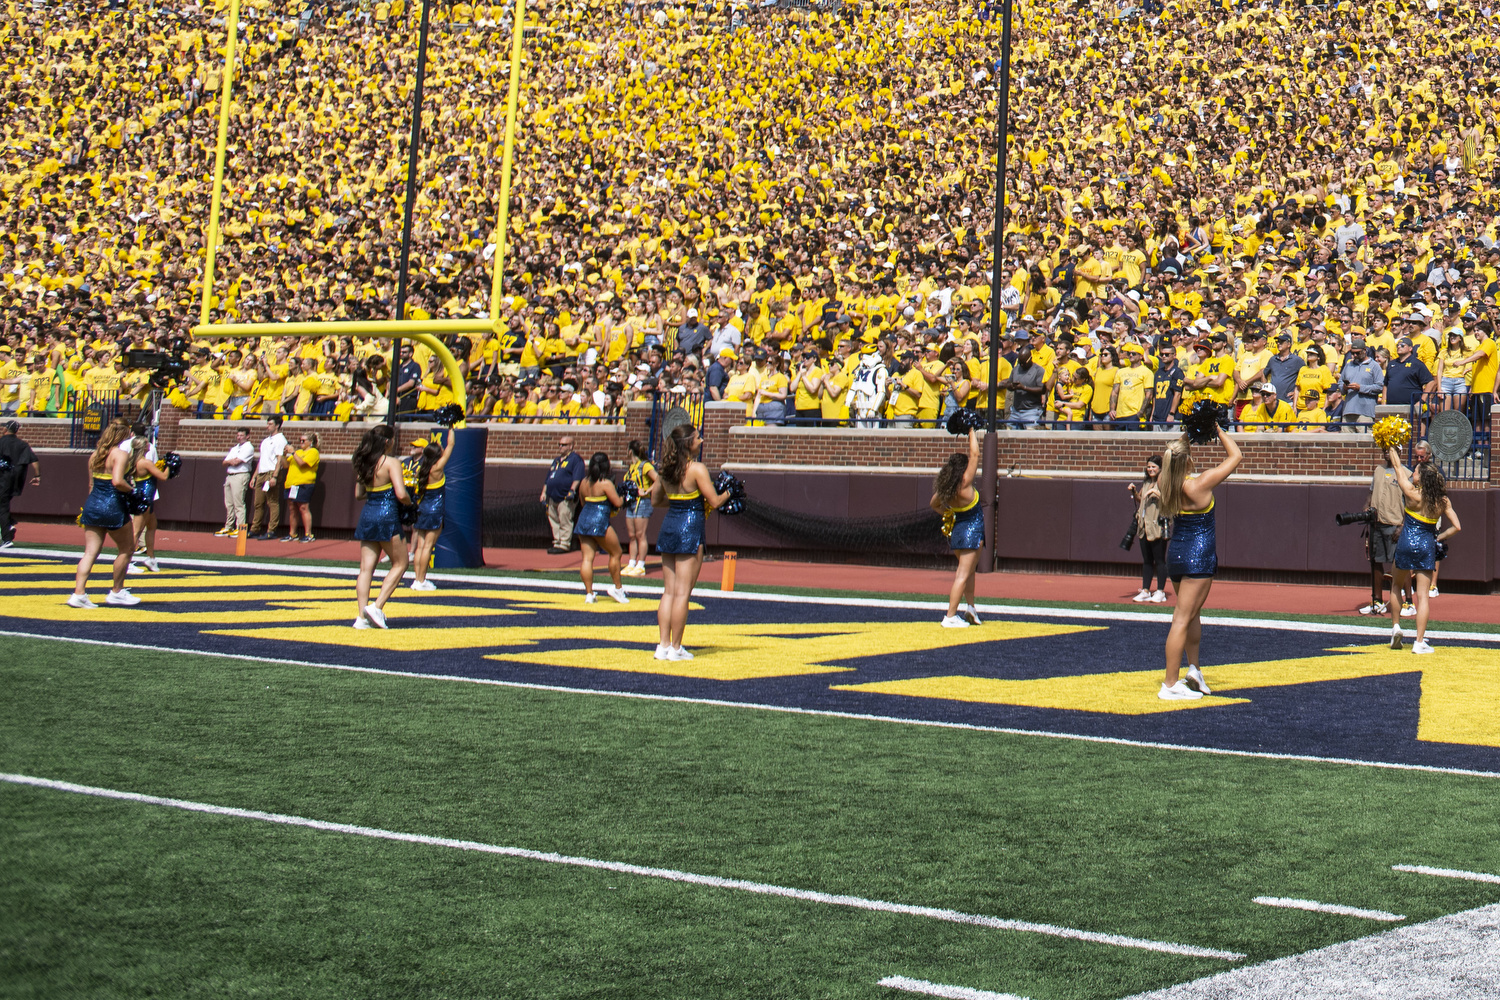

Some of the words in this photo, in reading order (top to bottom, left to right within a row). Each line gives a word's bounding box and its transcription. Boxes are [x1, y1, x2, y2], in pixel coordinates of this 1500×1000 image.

[1208, 362, 1220, 373] M
[857, 370, 870, 383] M
[1155, 381, 1170, 399] 97
[560, 410, 570, 419] M
[430, 432, 442, 445] M
